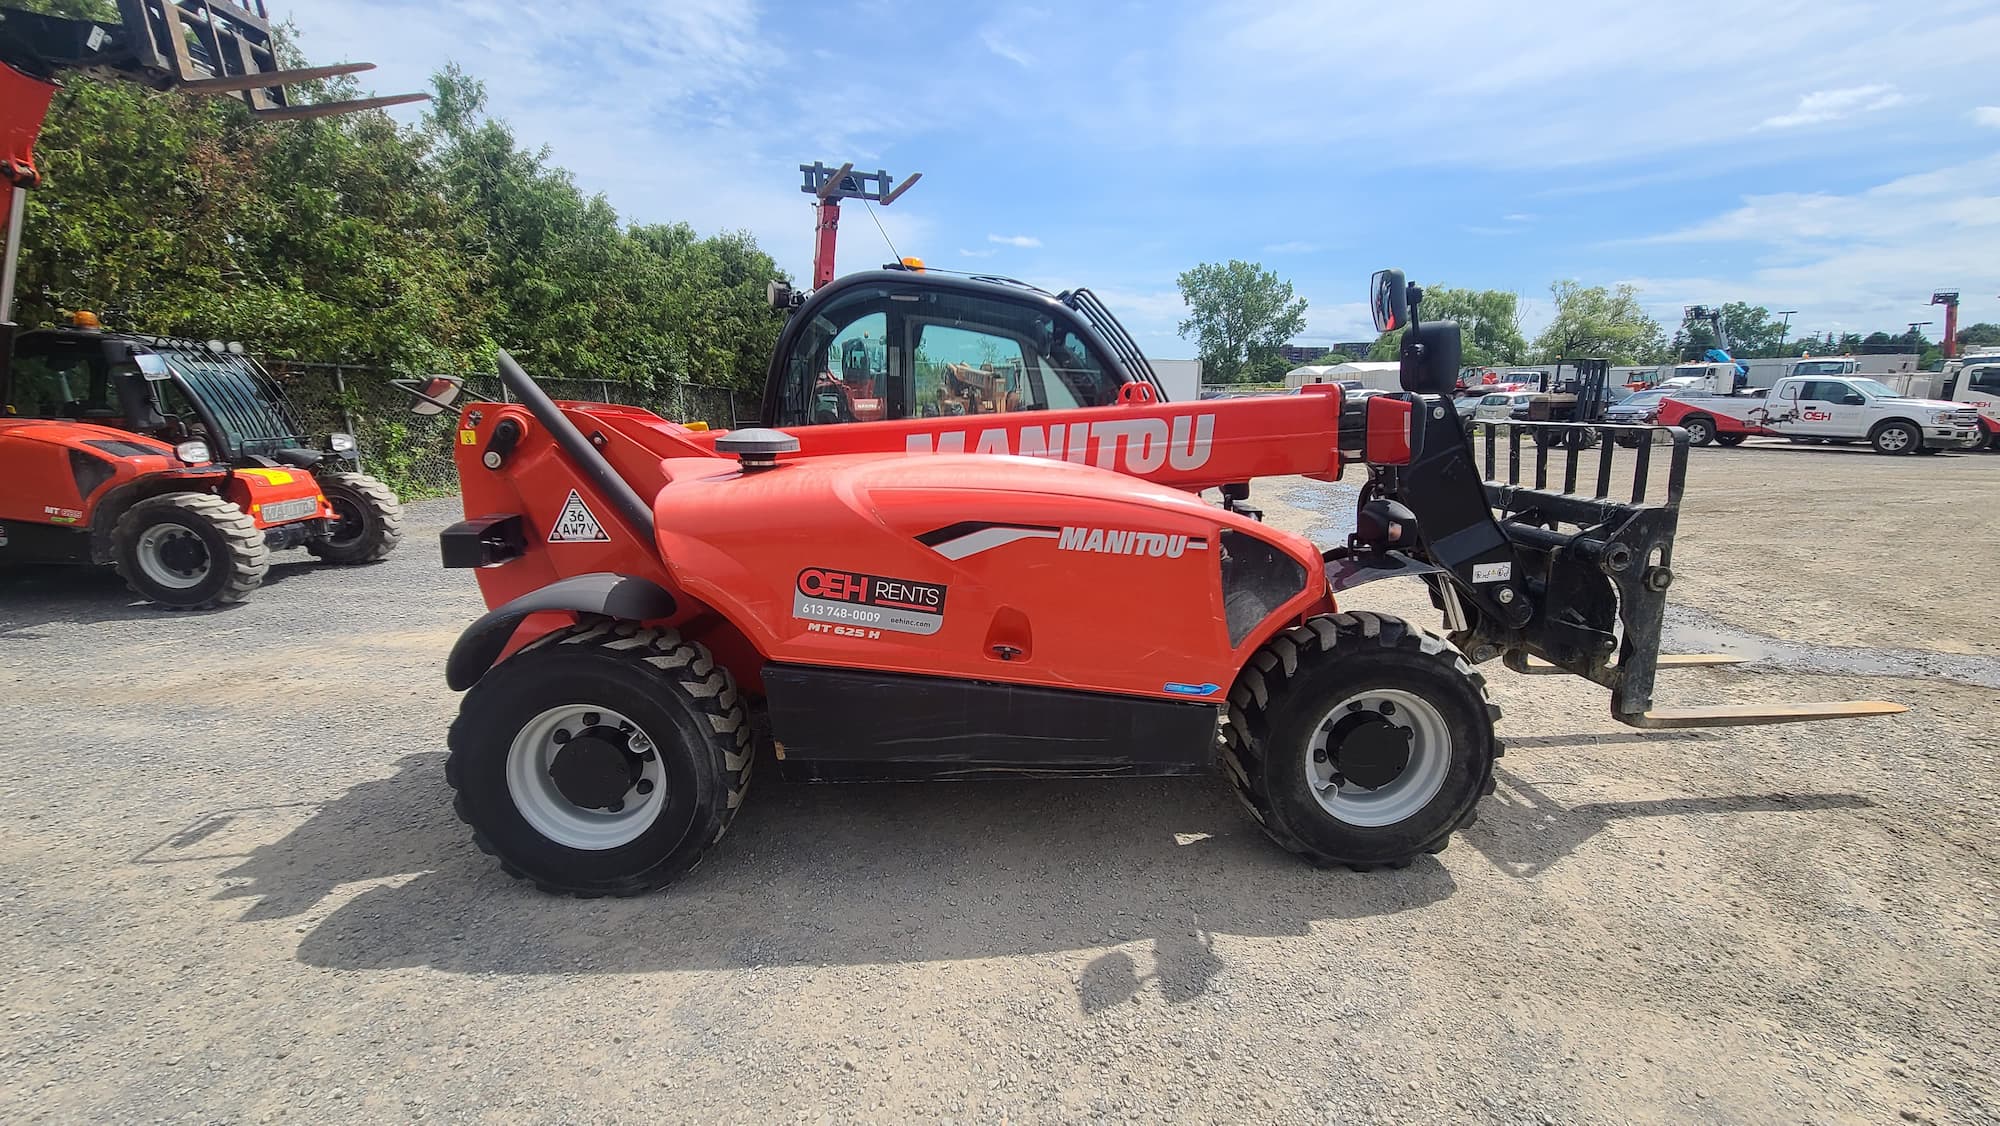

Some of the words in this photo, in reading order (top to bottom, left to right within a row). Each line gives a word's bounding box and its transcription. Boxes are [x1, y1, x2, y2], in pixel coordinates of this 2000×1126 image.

[1803, 411, 1832, 421] OEH
[569, 510, 585, 522] 36
[563, 523, 594, 535] AW7Y
[1058, 526, 1188, 559] MANITOU
[799, 569, 869, 603] OEH
[875, 581, 940, 606] RENTS
[802, 603, 824, 616] 613
[827, 606, 881, 623] 748-0009
[890, 617, 931, 629] oehinc.com
[808, 622, 833, 633] MT
[834, 626, 865, 639] 625
[868, 630, 881, 640] H
